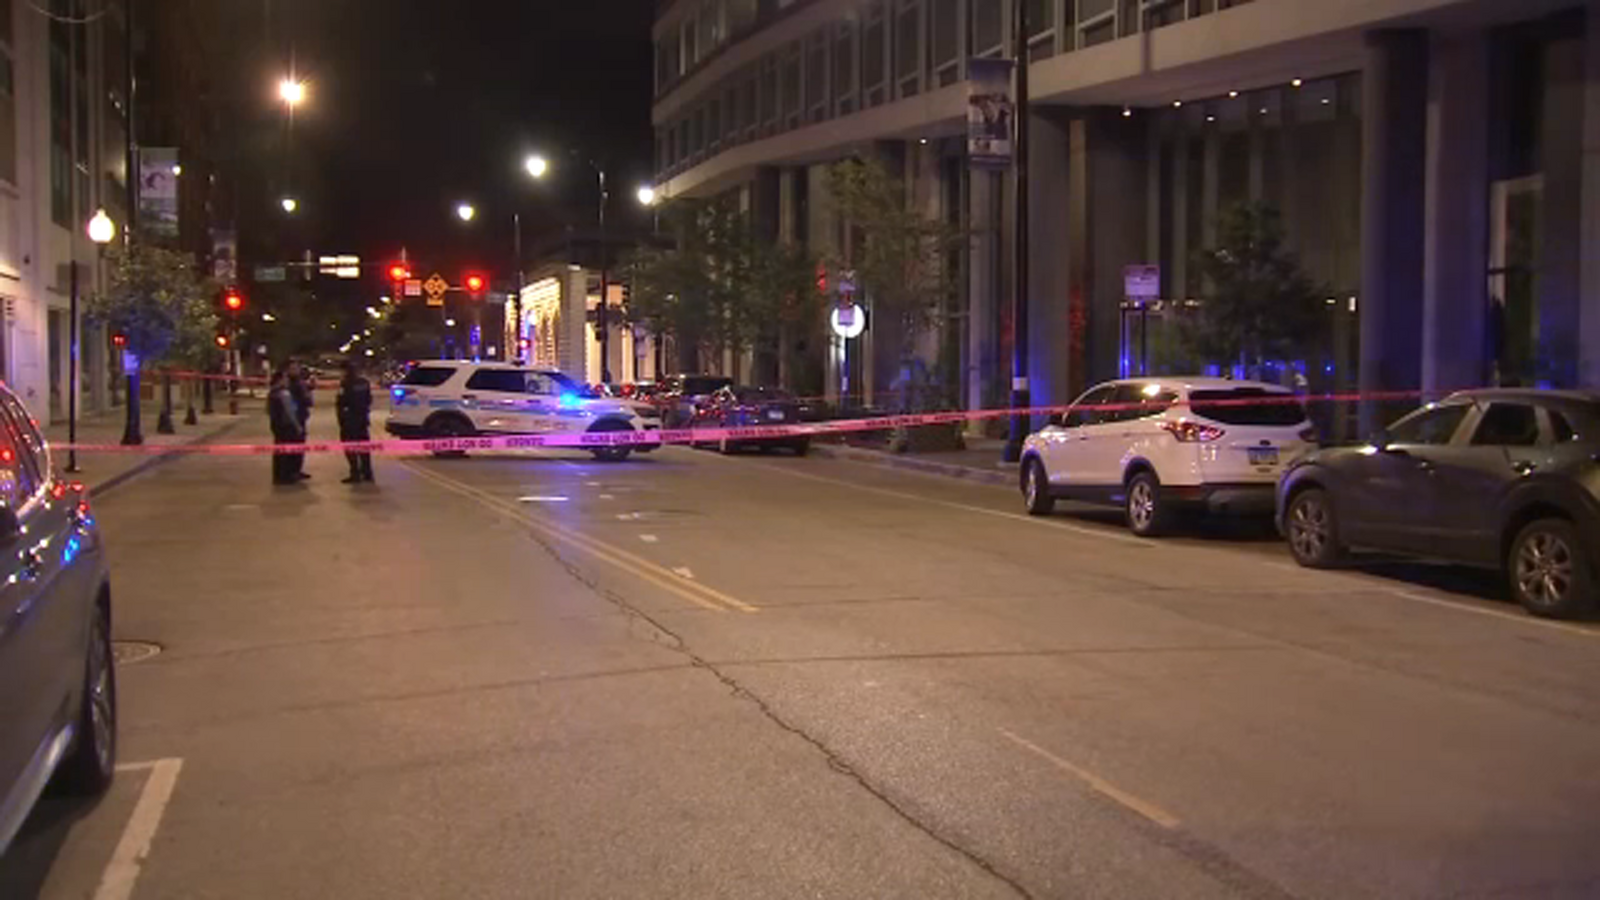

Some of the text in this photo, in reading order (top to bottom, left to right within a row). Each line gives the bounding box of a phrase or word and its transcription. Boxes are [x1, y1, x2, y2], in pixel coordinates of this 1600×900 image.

[580, 434, 610, 444] ENTER
[612, 434, 630, 443] NOT
[633, 432, 646, 442] DO
[422, 437, 545, 451] DANGER DO NOT ENTER
